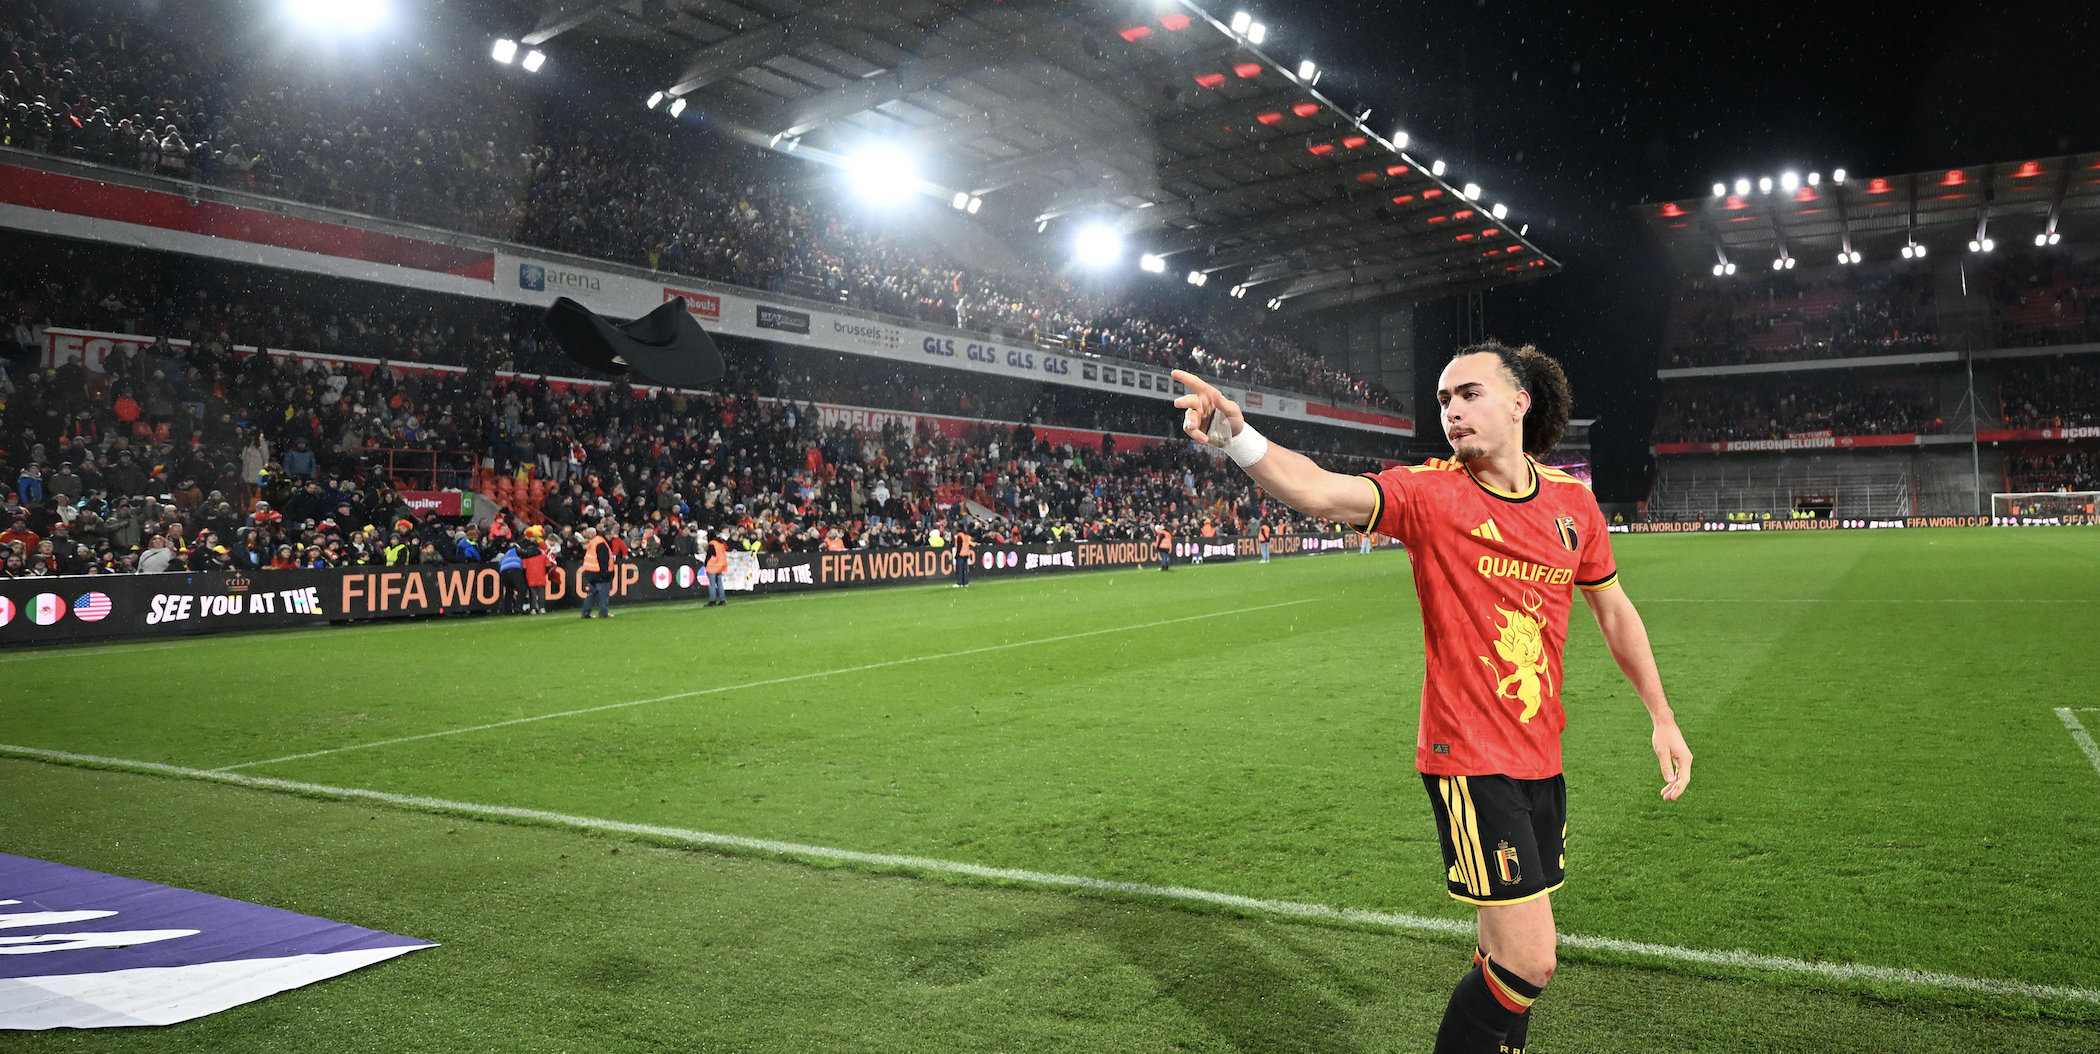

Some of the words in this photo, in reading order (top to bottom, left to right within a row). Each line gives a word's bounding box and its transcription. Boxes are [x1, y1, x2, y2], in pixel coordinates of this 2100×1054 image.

[546, 269, 600, 290] arena
[834, 319, 881, 339] brussels
[1727, 437, 1835, 451] #COMEONBELGIUM
[1631, 522, 1649, 533] FIFA
[1650, 522, 1682, 532] WORLD
[1683, 521, 1701, 532] CUP
[1763, 520, 1783, 530] FIFA
[1783, 519, 1818, 530] WORLD
[1819, 519, 1840, 530] CUP
[1906, 518, 1928, 528] FIFA
[1929, 517, 1966, 528] WORLD
[1967, 516, 1989, 527] CUP
[1078, 544, 1104, 566] FIFA
[1106, 542, 1148, 565] WORLD
[1237, 538, 1256, 556] FIFA
[1285, 536, 1301, 554] CUP
[778, 567, 791, 583] AT
[792, 563, 814, 584] THE
[821, 553, 865, 583] FIFA
[868, 550, 936, 580] WORLD
[1477, 555, 1574, 585] QUALIFIED
[145, 593, 194, 625] SEE
[200, 594, 243, 617] YOU
[249, 592, 275, 614] AT
[280, 586, 323, 615] THE
[342, 571, 427, 613] FIFA
[437, 566, 566, 607] WOD
